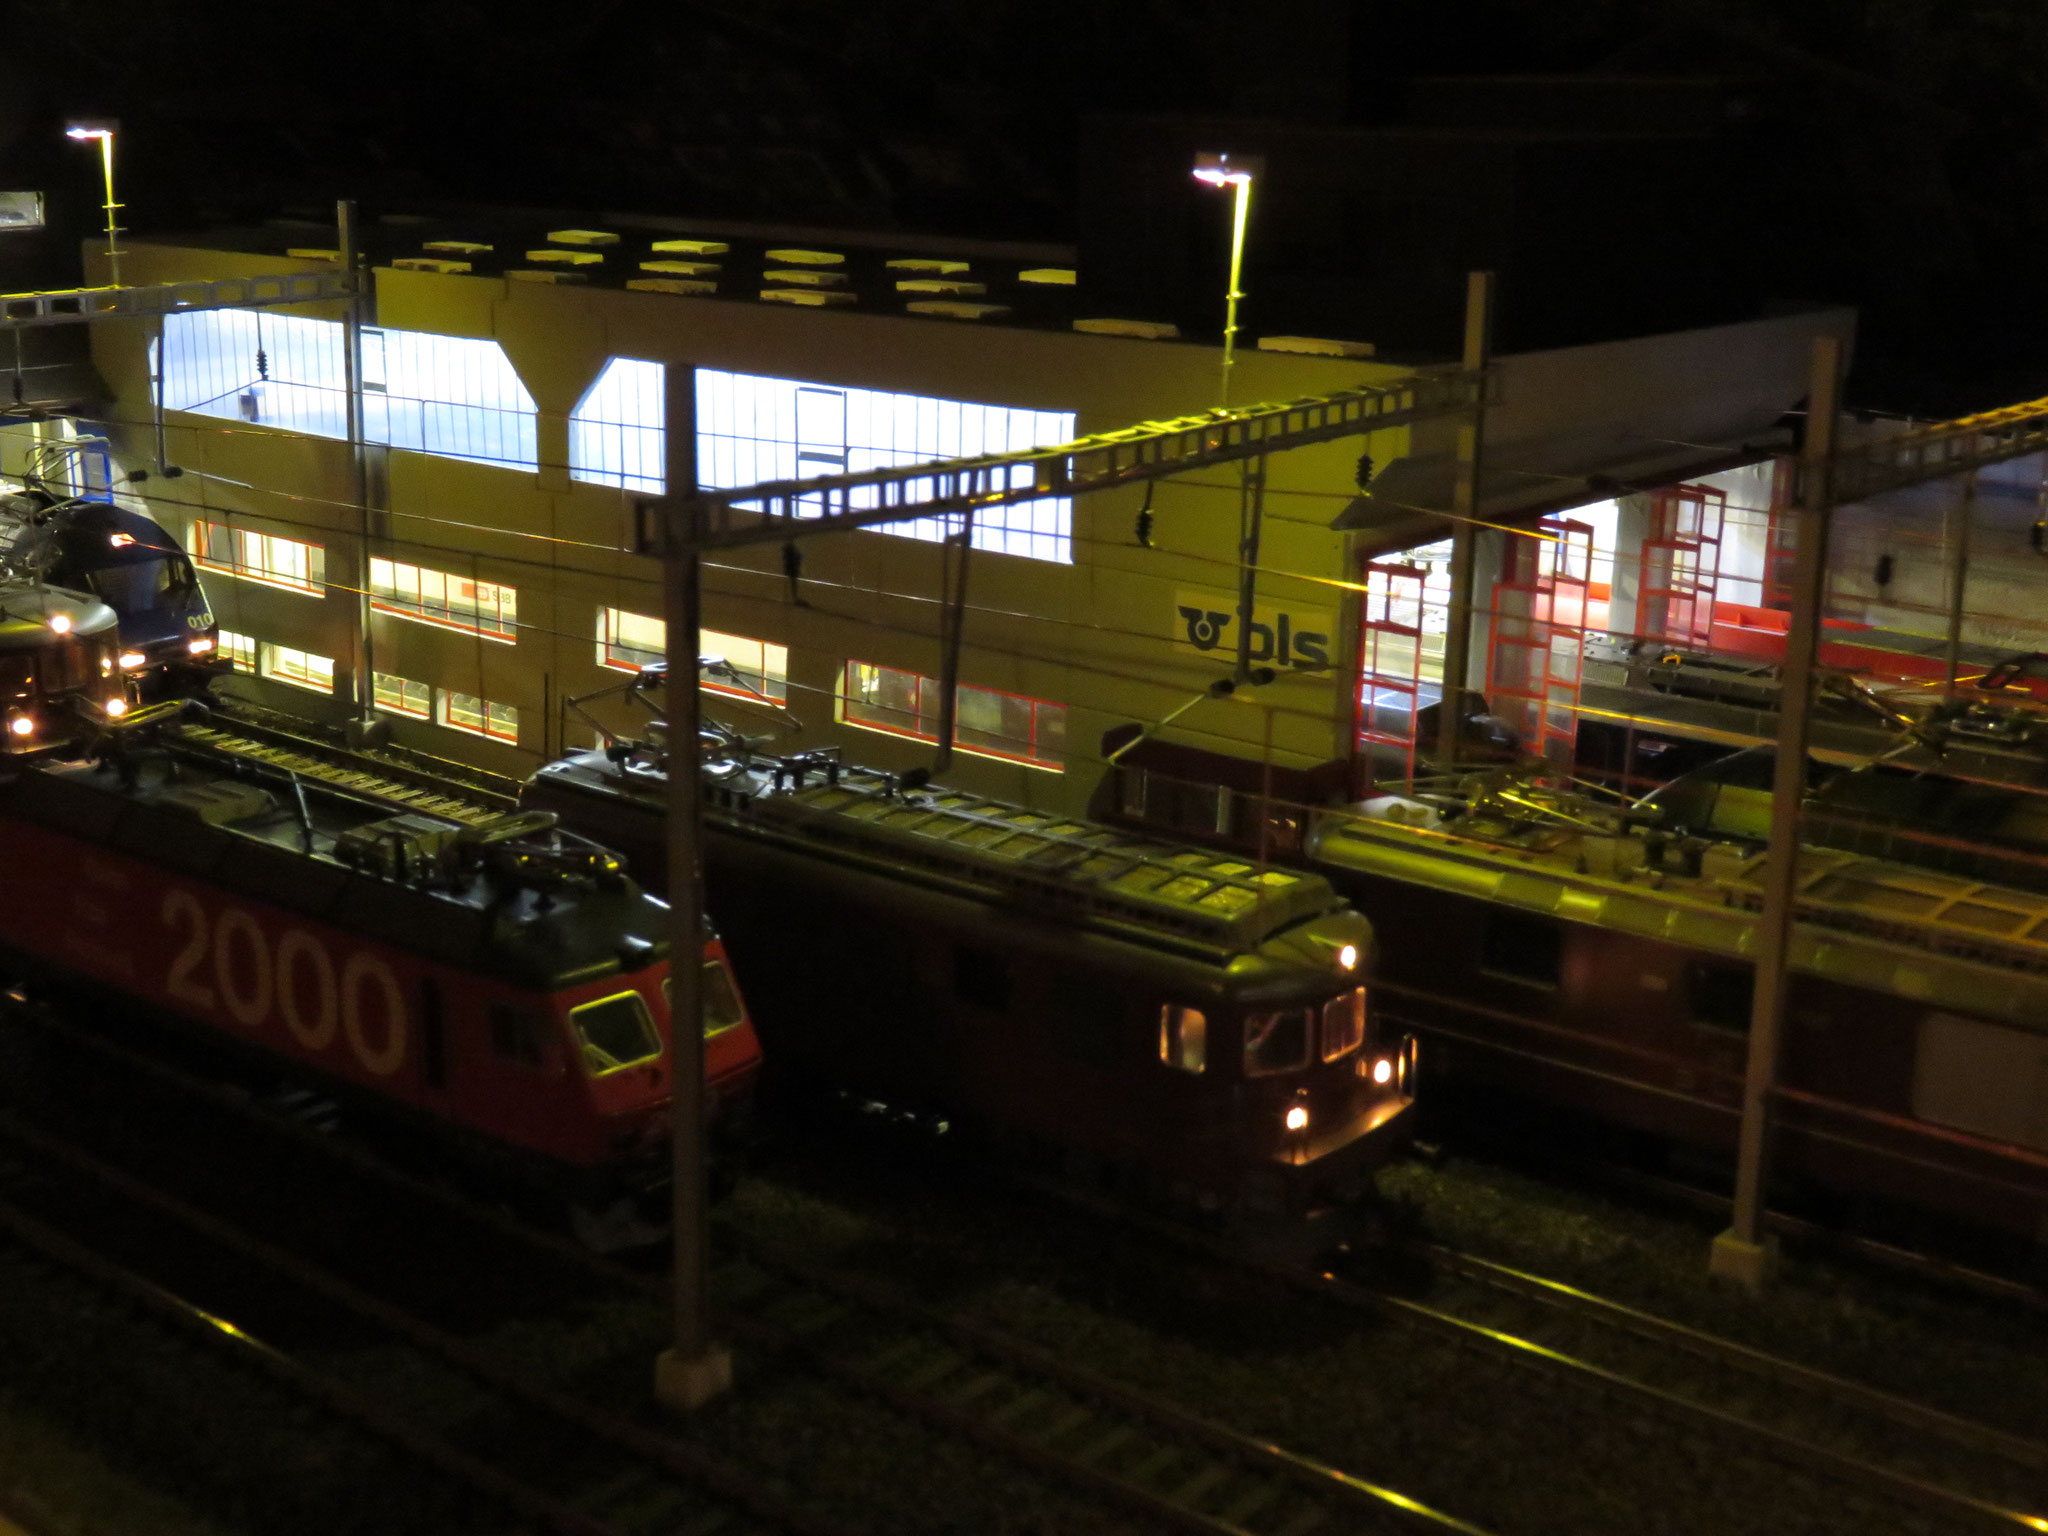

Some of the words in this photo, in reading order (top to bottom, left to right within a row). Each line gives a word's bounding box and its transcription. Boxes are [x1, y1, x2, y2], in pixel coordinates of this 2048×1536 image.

[187, 613, 212, 629] 010
[1238, 606, 1329, 672] bls
[162, 889, 406, 1076] 2000
